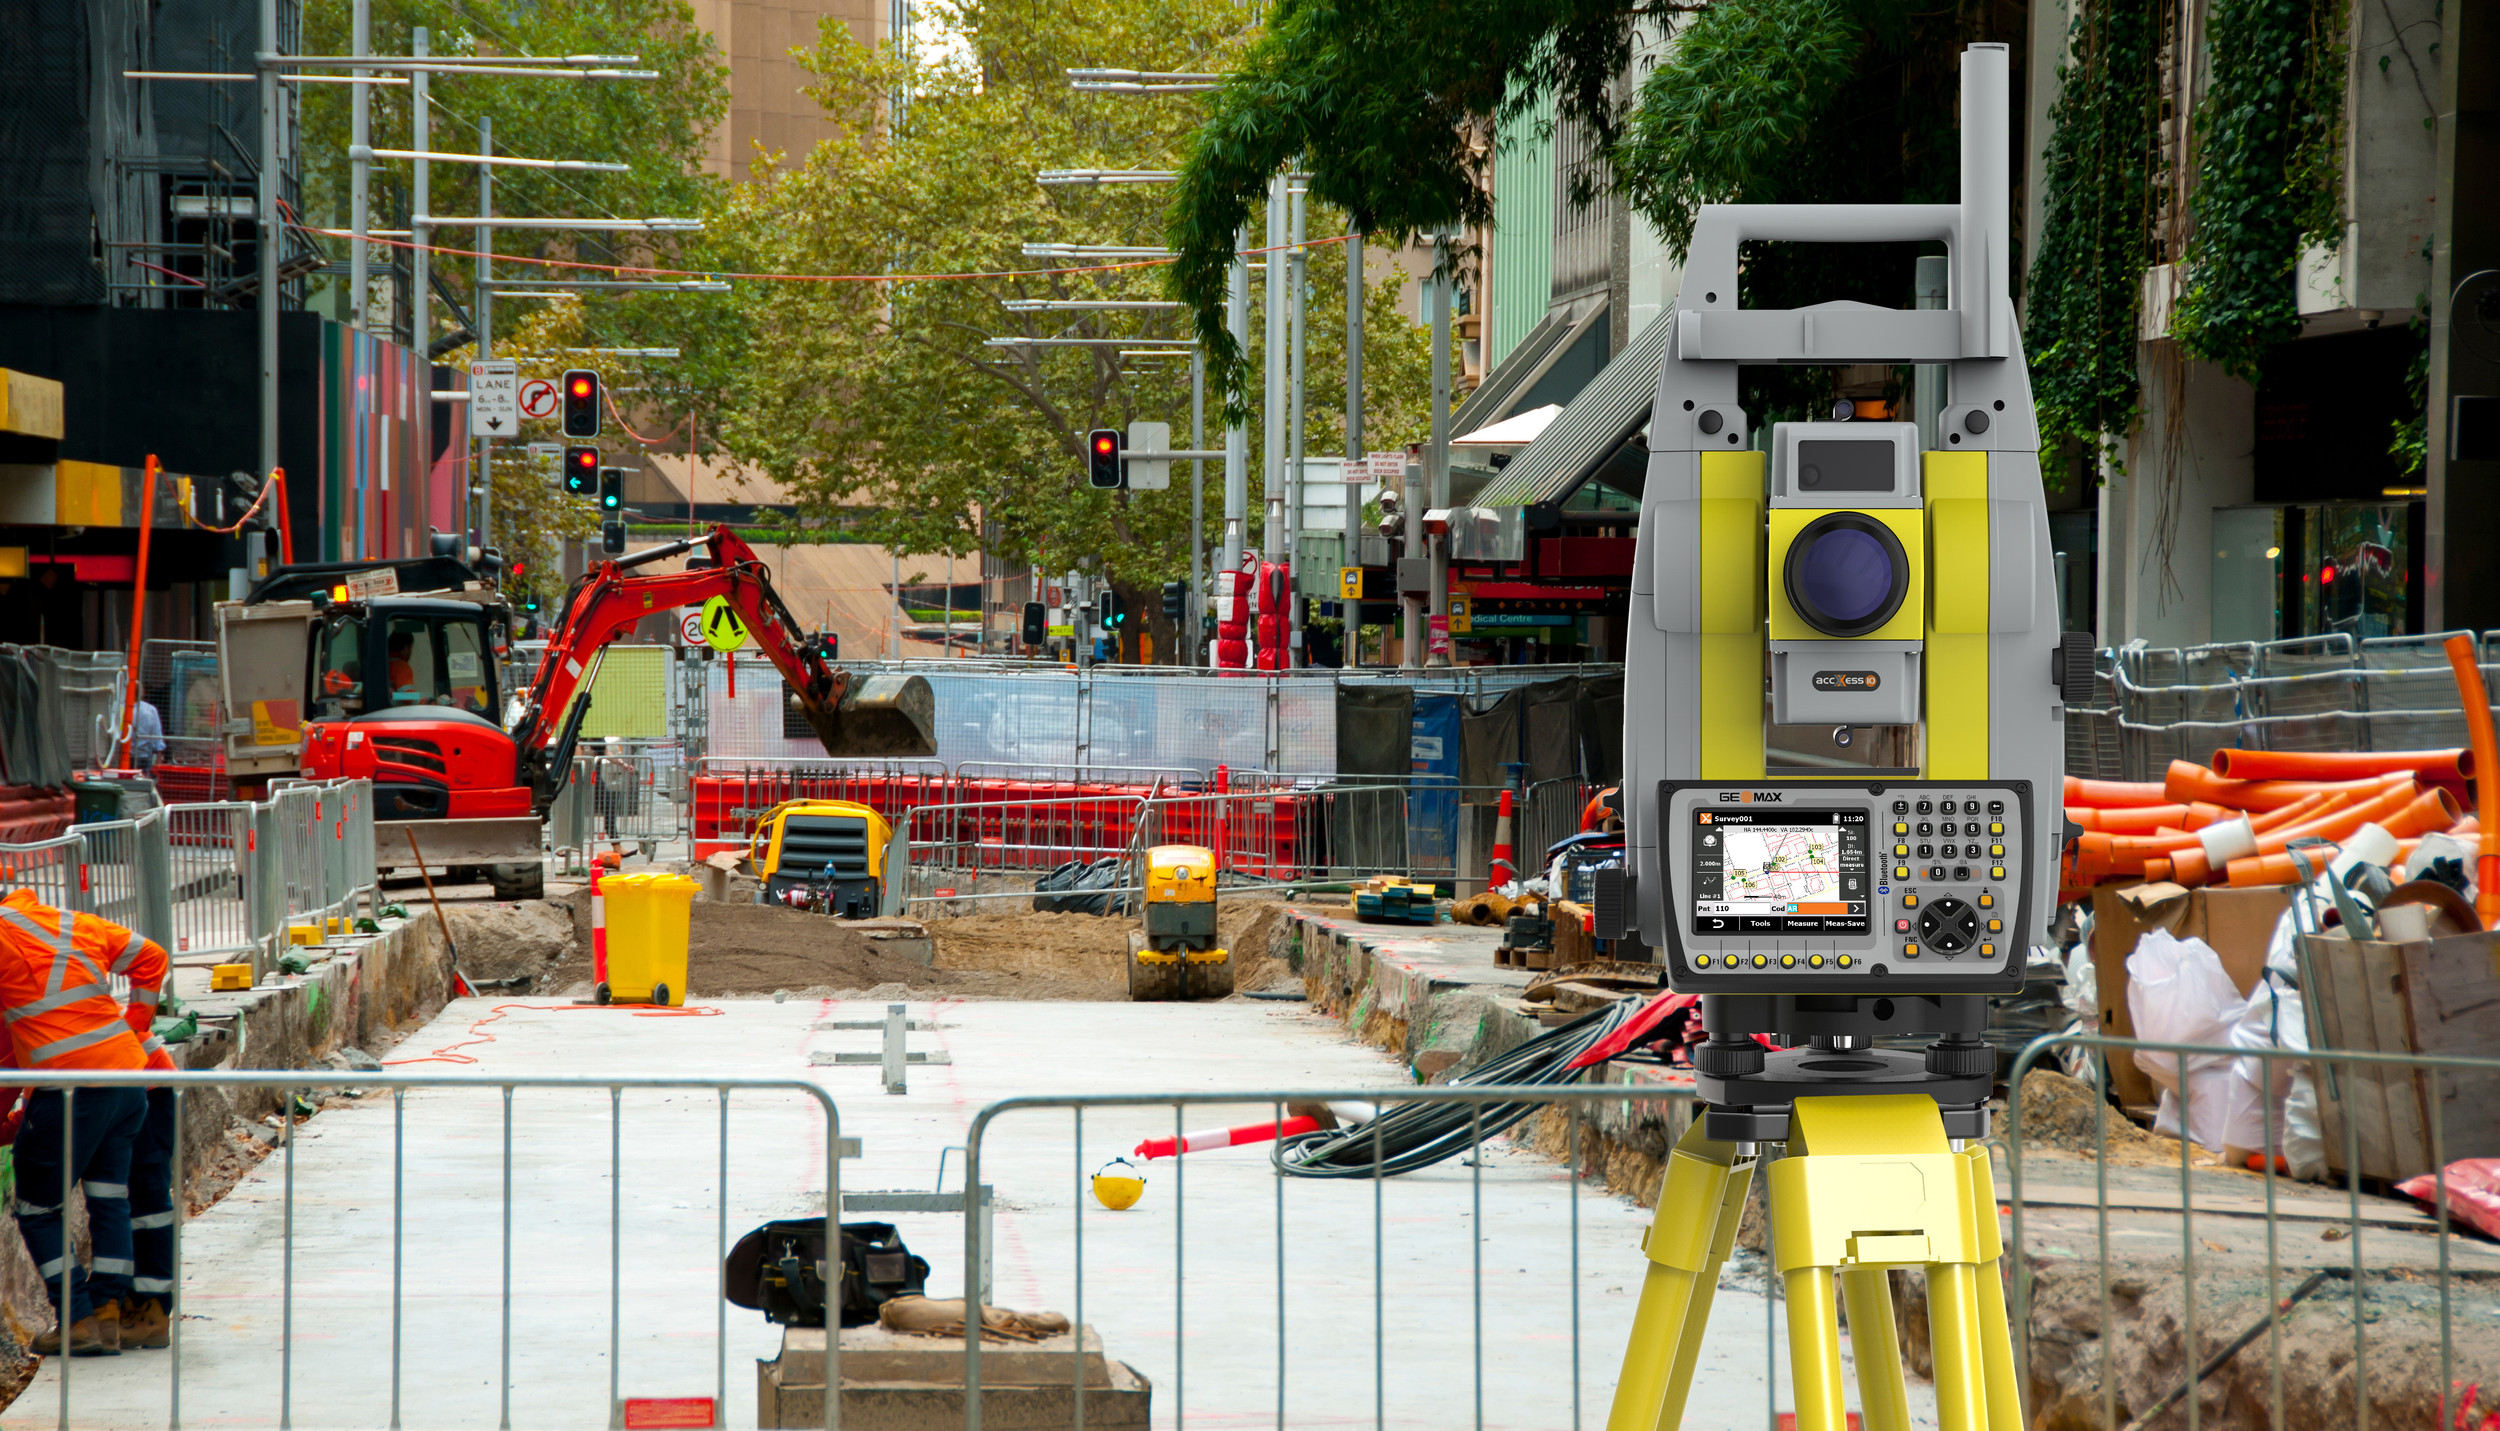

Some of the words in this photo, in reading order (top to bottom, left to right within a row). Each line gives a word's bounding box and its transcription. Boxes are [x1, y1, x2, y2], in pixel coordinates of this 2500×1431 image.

[476, 380, 511, 389] LANE
[1471, 614, 1497, 623] edical
[1500, 615, 1533, 623] Centre
[1816, 674, 1864, 687] accXess
[1714, 815, 1753, 823] Survey001
[1879, 853, 1888, 885] Bluetooth
